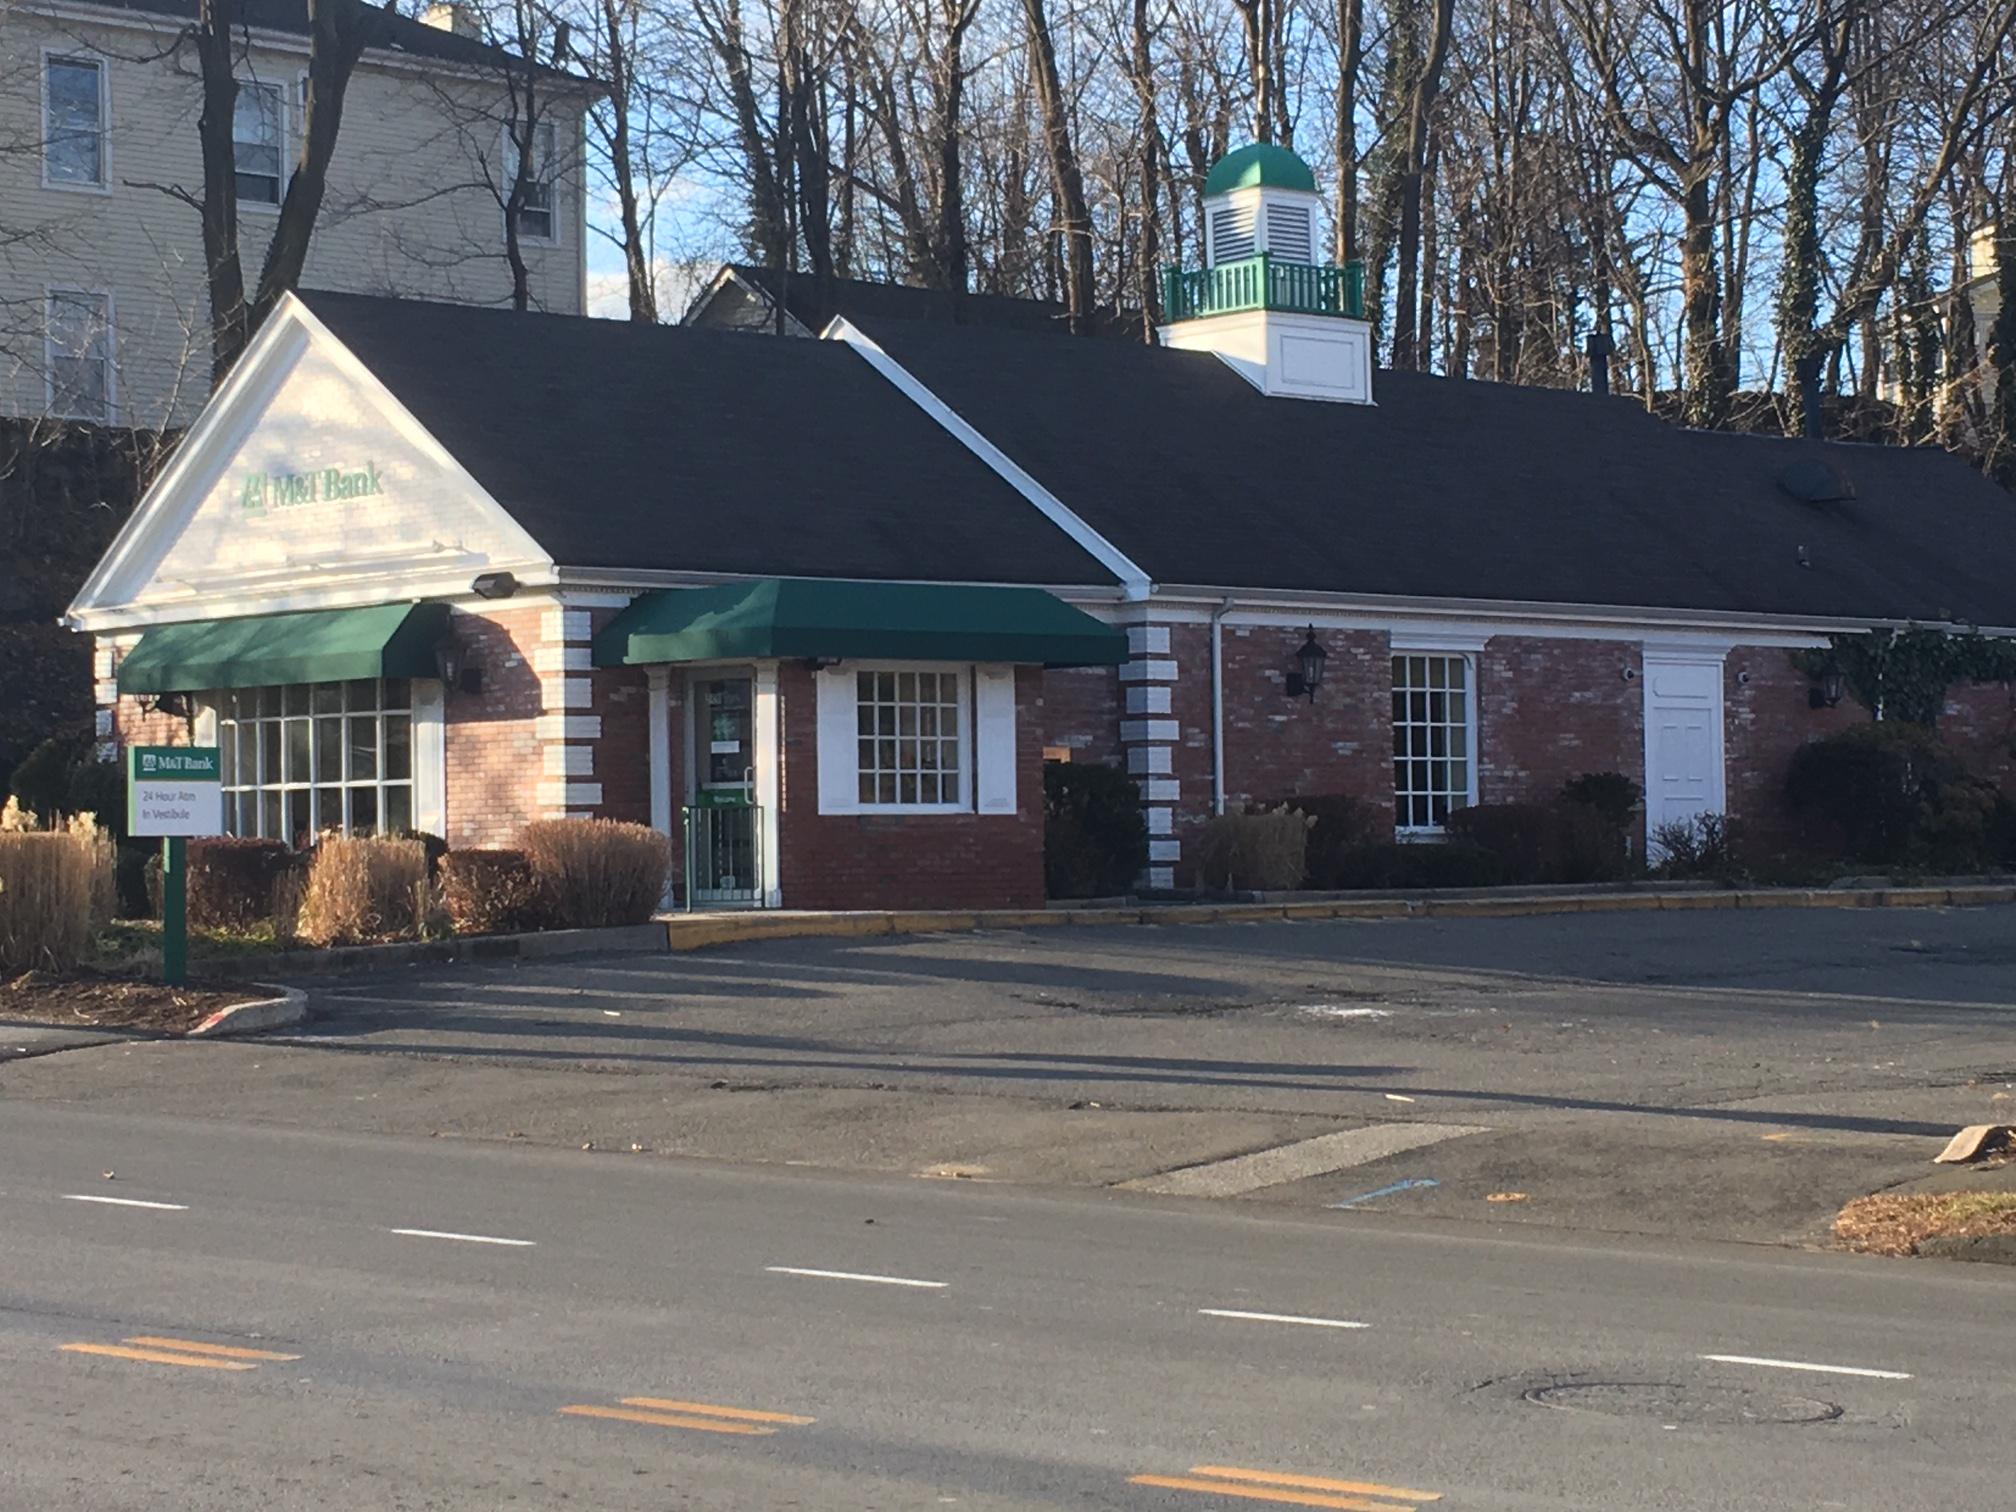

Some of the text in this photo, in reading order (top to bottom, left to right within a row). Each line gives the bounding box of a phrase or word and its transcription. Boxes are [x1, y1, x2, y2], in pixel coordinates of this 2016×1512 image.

[273, 460, 384, 508] M&T Bank
[158, 756, 213, 770] M&T Bank
[143, 791, 153, 801] 24
[155, 791, 176, 801] Hour
[143, 809, 190, 819] In Vestibule
